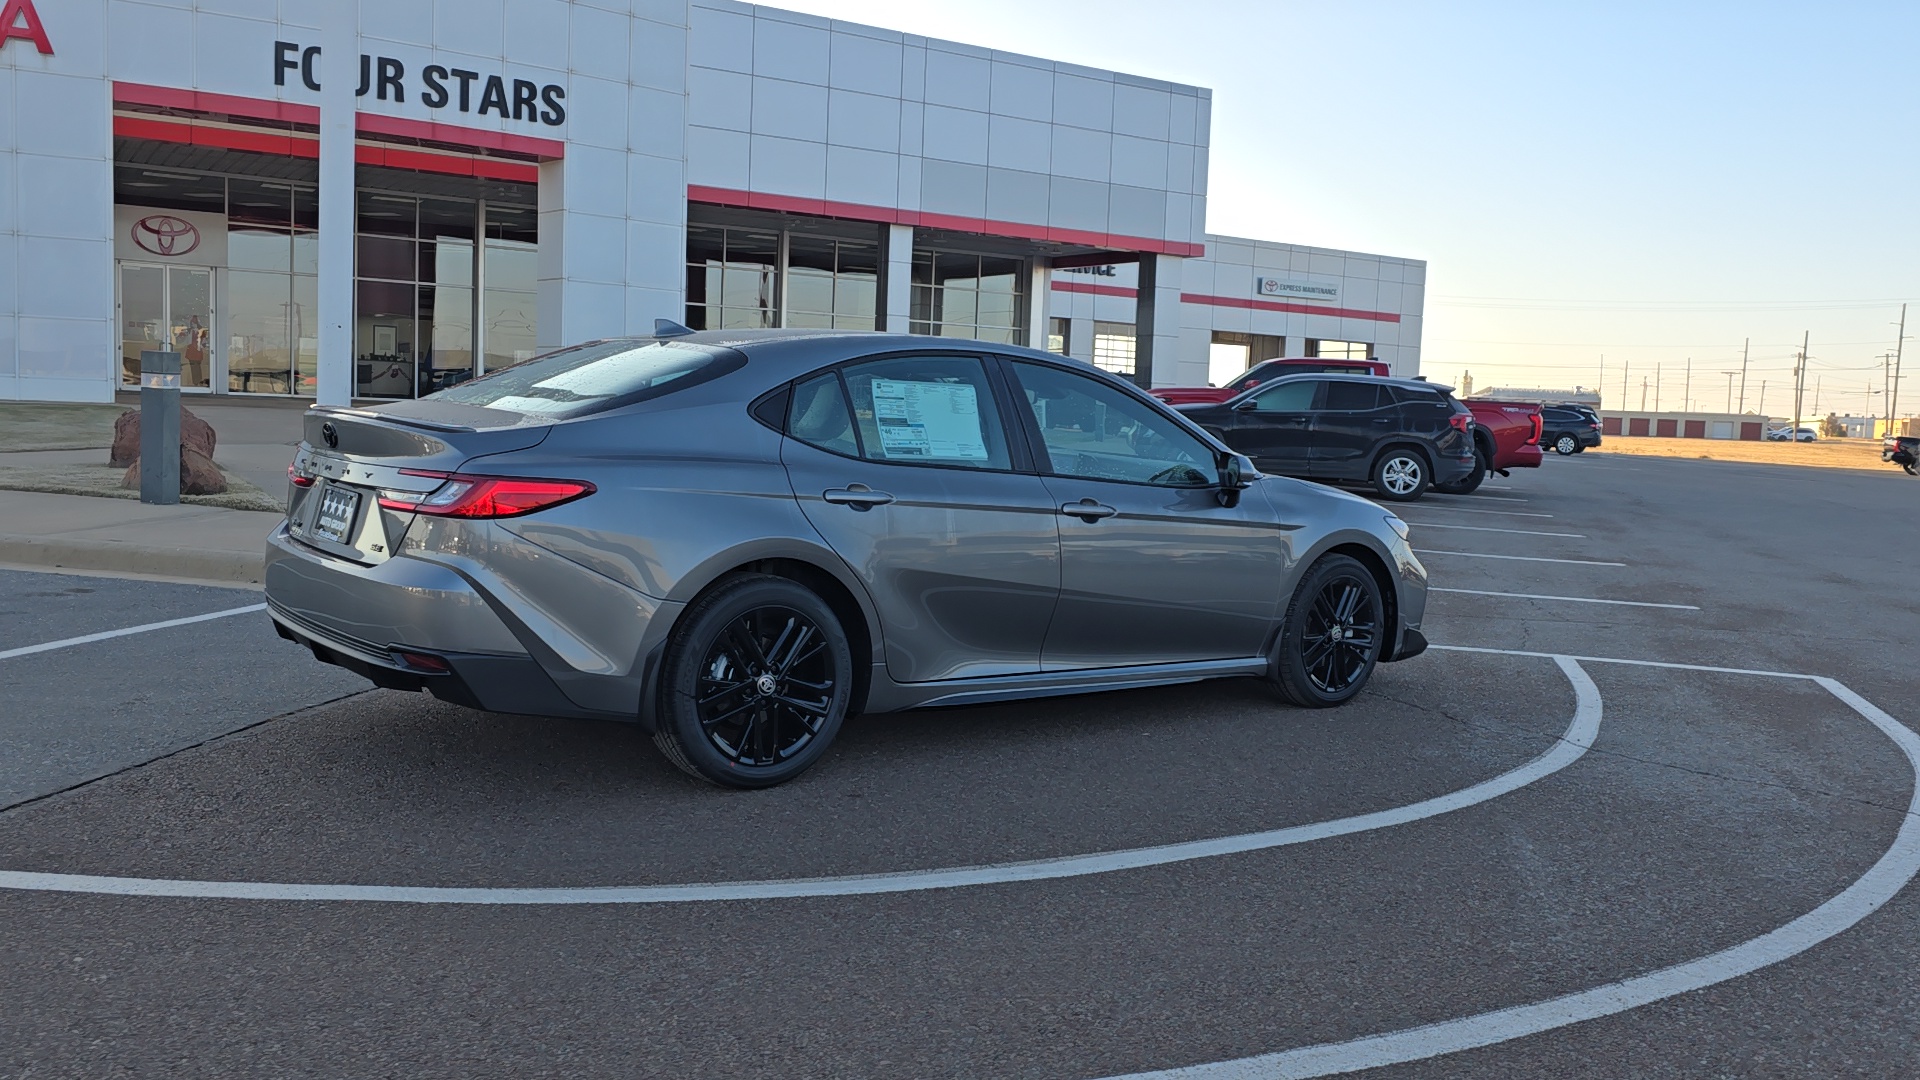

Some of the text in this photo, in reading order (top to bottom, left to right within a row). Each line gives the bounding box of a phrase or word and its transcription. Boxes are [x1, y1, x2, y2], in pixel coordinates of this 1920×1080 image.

[421, 64, 566, 127] STARS
[1279, 283, 1337, 296] EXPRESS MAINTENANCE
